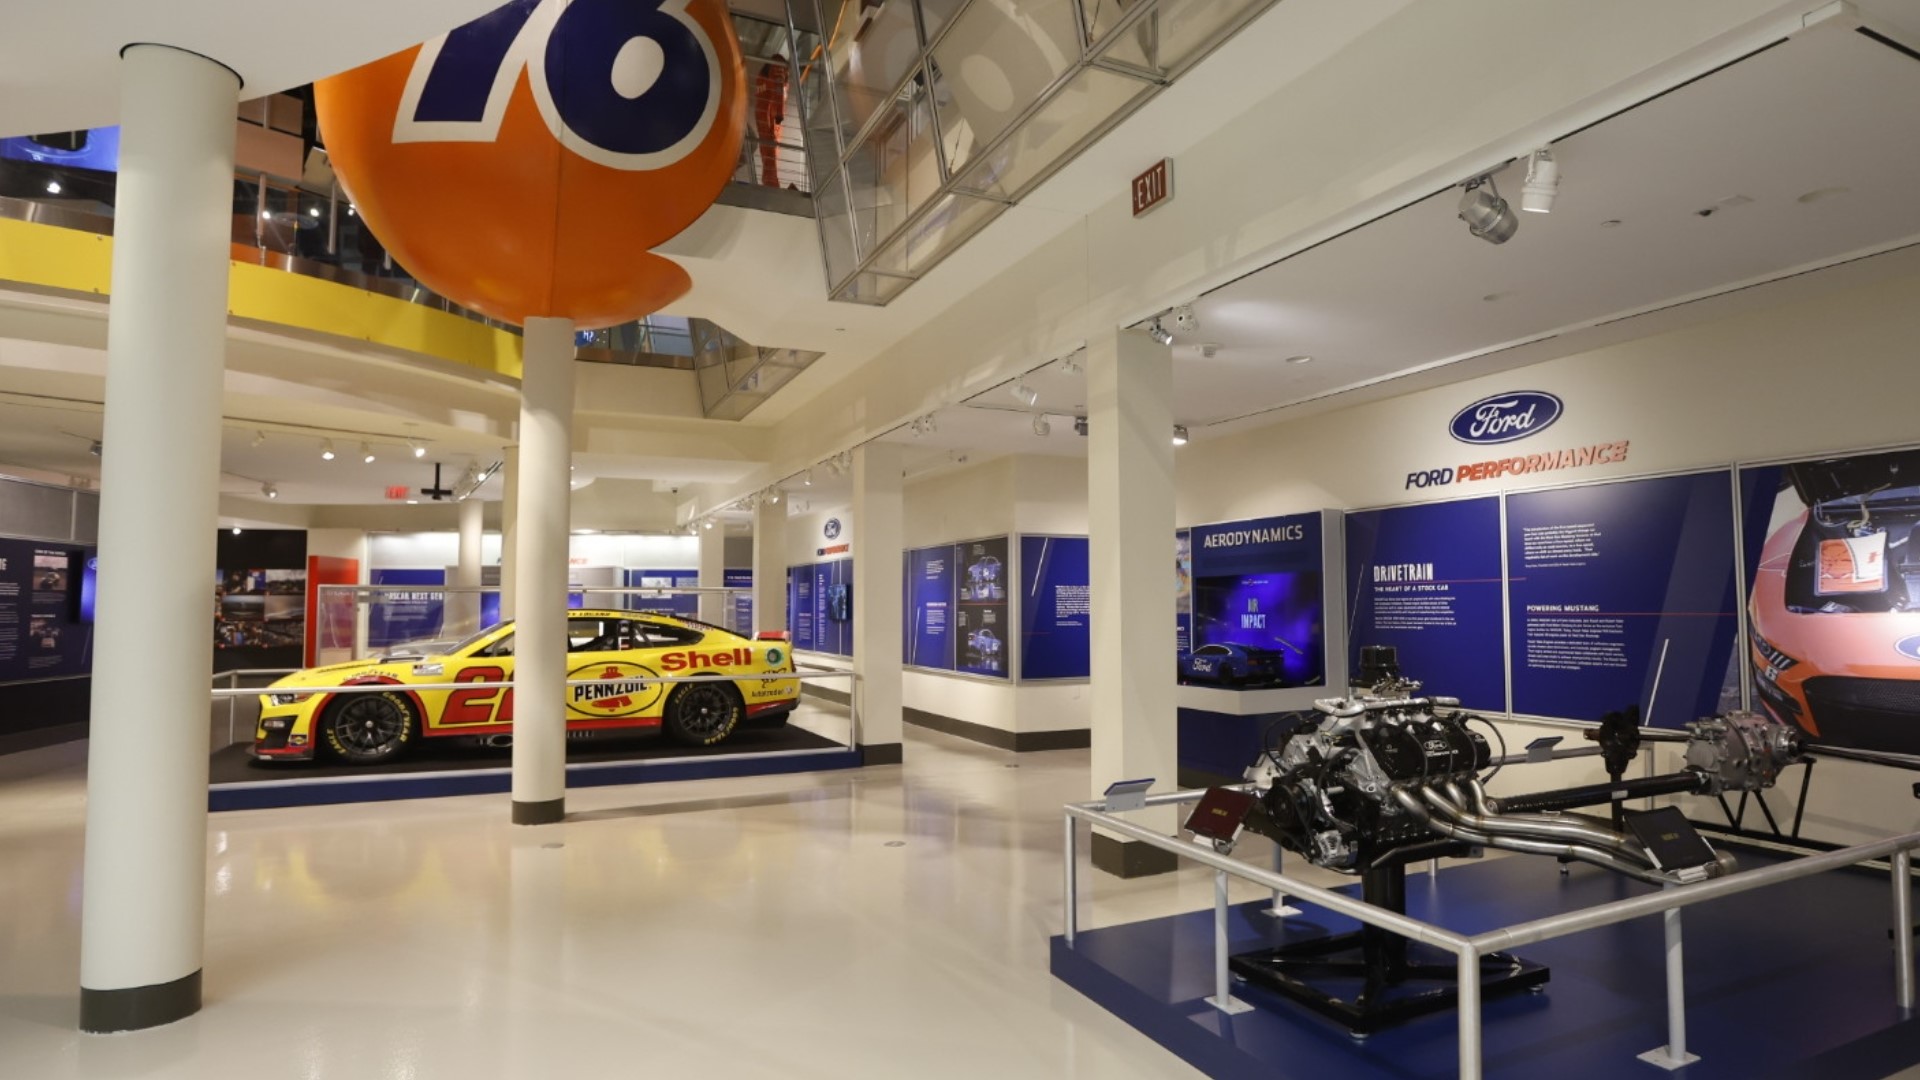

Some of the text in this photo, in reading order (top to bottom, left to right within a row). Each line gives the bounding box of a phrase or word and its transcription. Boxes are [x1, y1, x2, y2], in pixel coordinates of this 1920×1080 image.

[1137, 166, 1163, 210] EXIT
[1470, 398, 1537, 438] Ford
[1405, 440, 1630, 490] FORD PERFORMANCE
[1203, 525, 1304, 549] AERODYNAMICS
[1373, 562, 1434, 582] DRIVETRAIN
[1526, 604, 1599, 612] POWERING MUSTANG
[1241, 614, 1266, 629] IMPACT
[660, 647, 752, 672] Shell
[438, 665, 515, 725] 2
